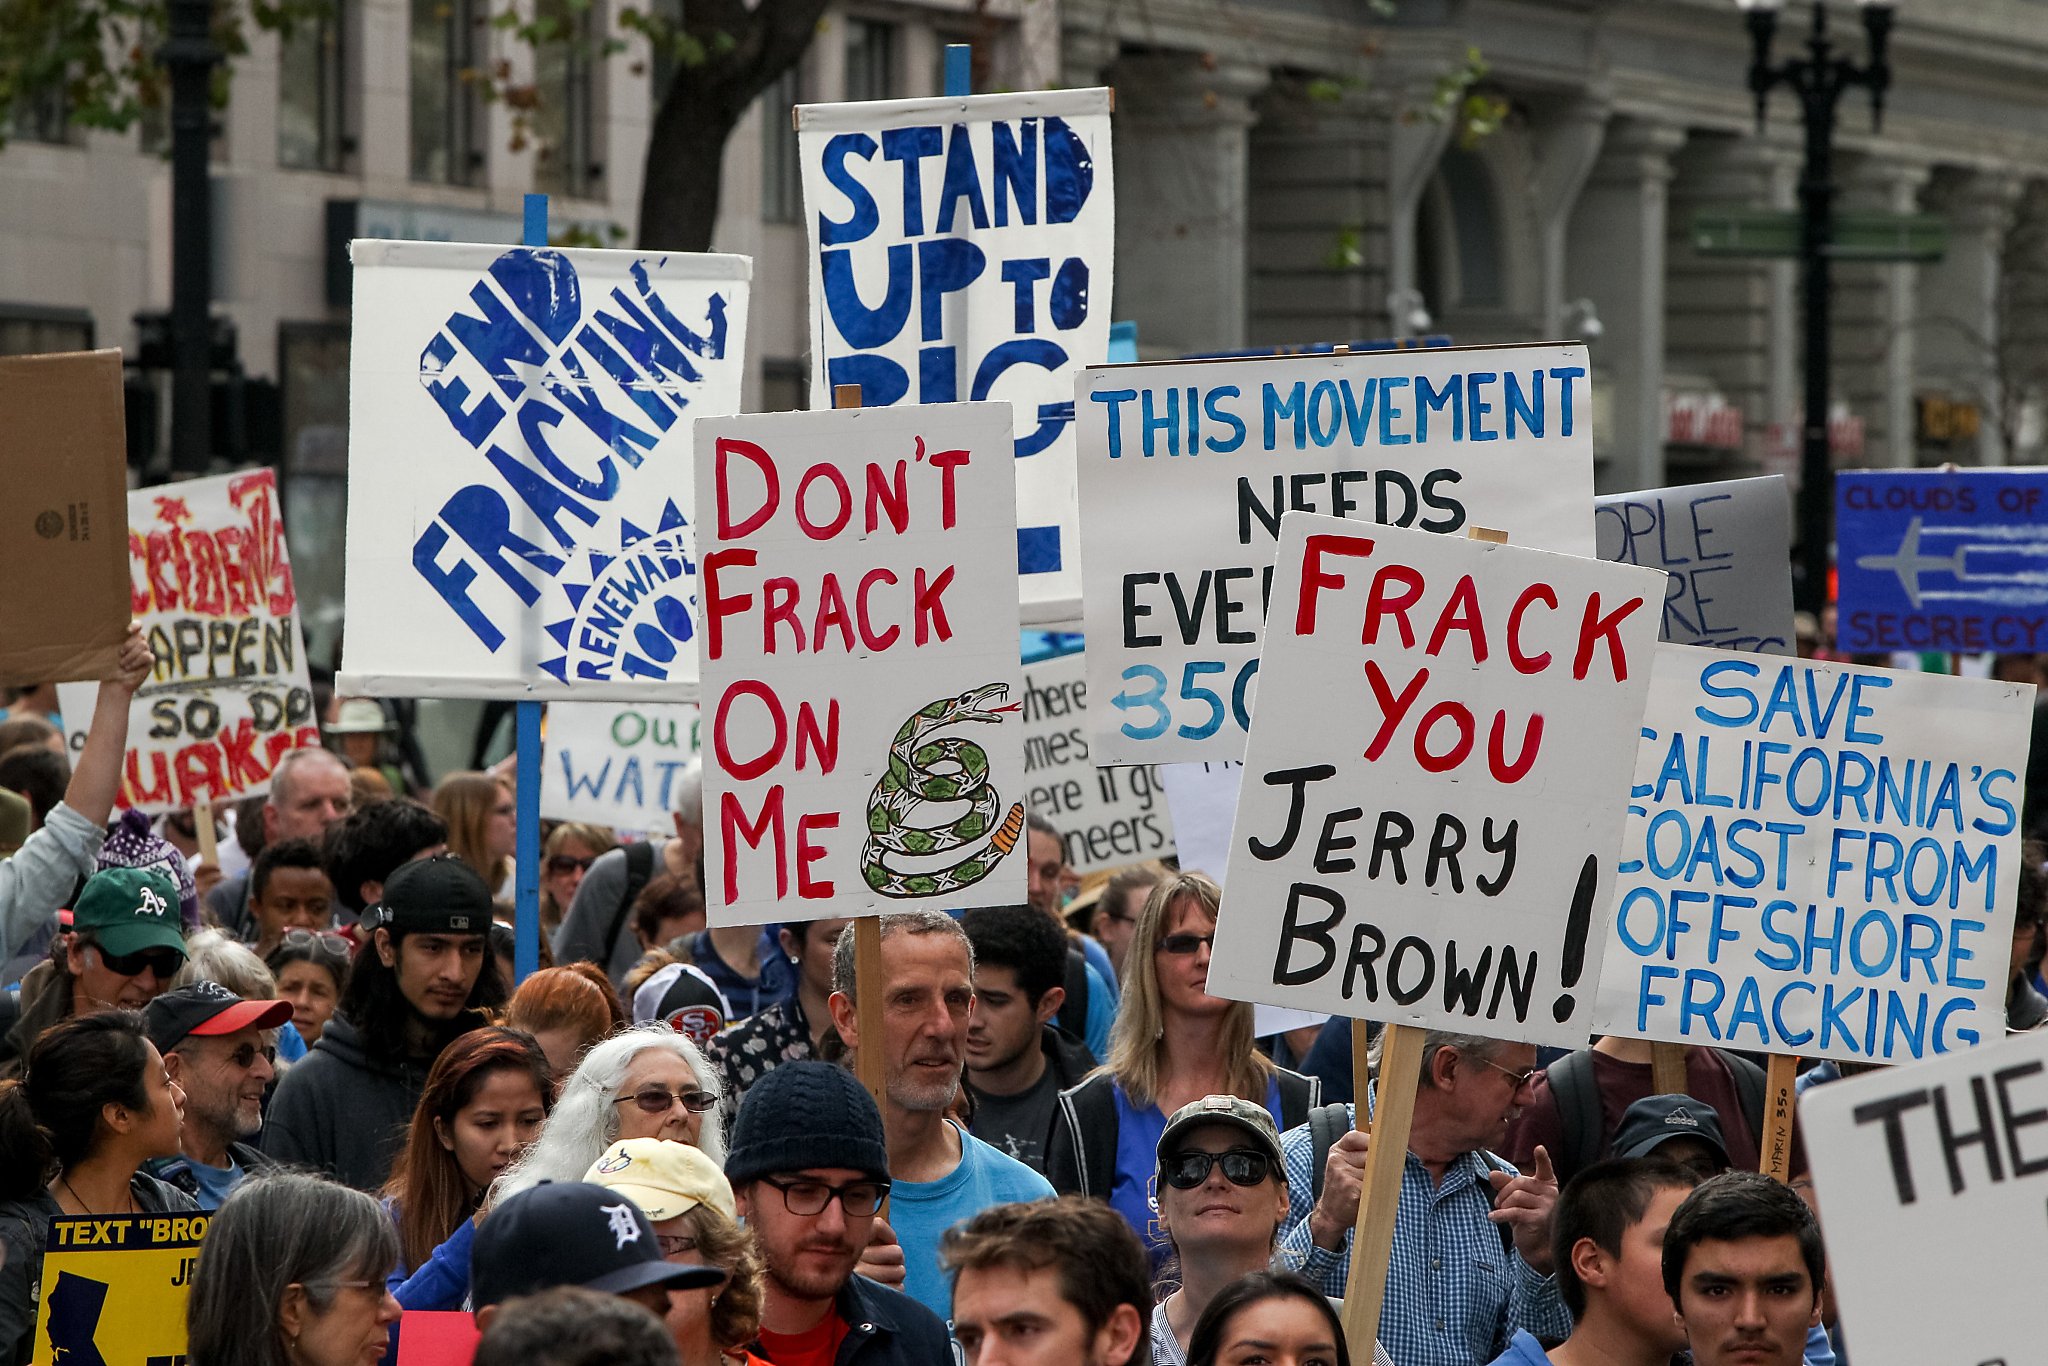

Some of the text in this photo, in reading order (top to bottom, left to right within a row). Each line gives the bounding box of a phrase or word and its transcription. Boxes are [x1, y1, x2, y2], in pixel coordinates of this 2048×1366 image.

[819, 116, 1094, 246] STAND
[821, 238, 1089, 350] UP TO
[419, 248, 582, 449] END
[413, 257, 728, 654] FRACKING
[1090, 385, 1247, 458] THIS
[1262, 367, 1585, 450] MOVEMENT
[715, 435, 971, 541] DON'T
[1237, 469, 1467, 544] NEEDS
[1845, 485, 2043, 515] CLOUDS OF
[150, 617, 294, 682] APPEN
[576, 534, 697, 682] RENEWABL
[703, 549, 955, 660] FRACK
[1122, 565, 1273, 648] EVE
[1295, 533, 1644, 683] FRACK
[1850, 612, 2045, 649] SECRECY
[149, 687, 312, 740] SO DO
[714, 679, 839, 780] ON
[1363, 660, 1545, 784] YOU
[1695, 660, 1893, 745] SAVE
[559, 748, 686, 812] WAT
[1248, 764, 1519, 897] JERRY
[721, 785, 841, 906] ME
[1827, 828, 1997, 913] FROM
[1273, 854, 1598, 1024] BROWN!
[1617, 886, 1986, 989] OFFSHORE
[1638, 965, 1981, 1060] FRACKING
[1770, 1087, 1788, 1173] MARIN 350
[1853, 1060, 2048, 1207] THE
[55, 1215, 214, 1245] TEXT "BRO
